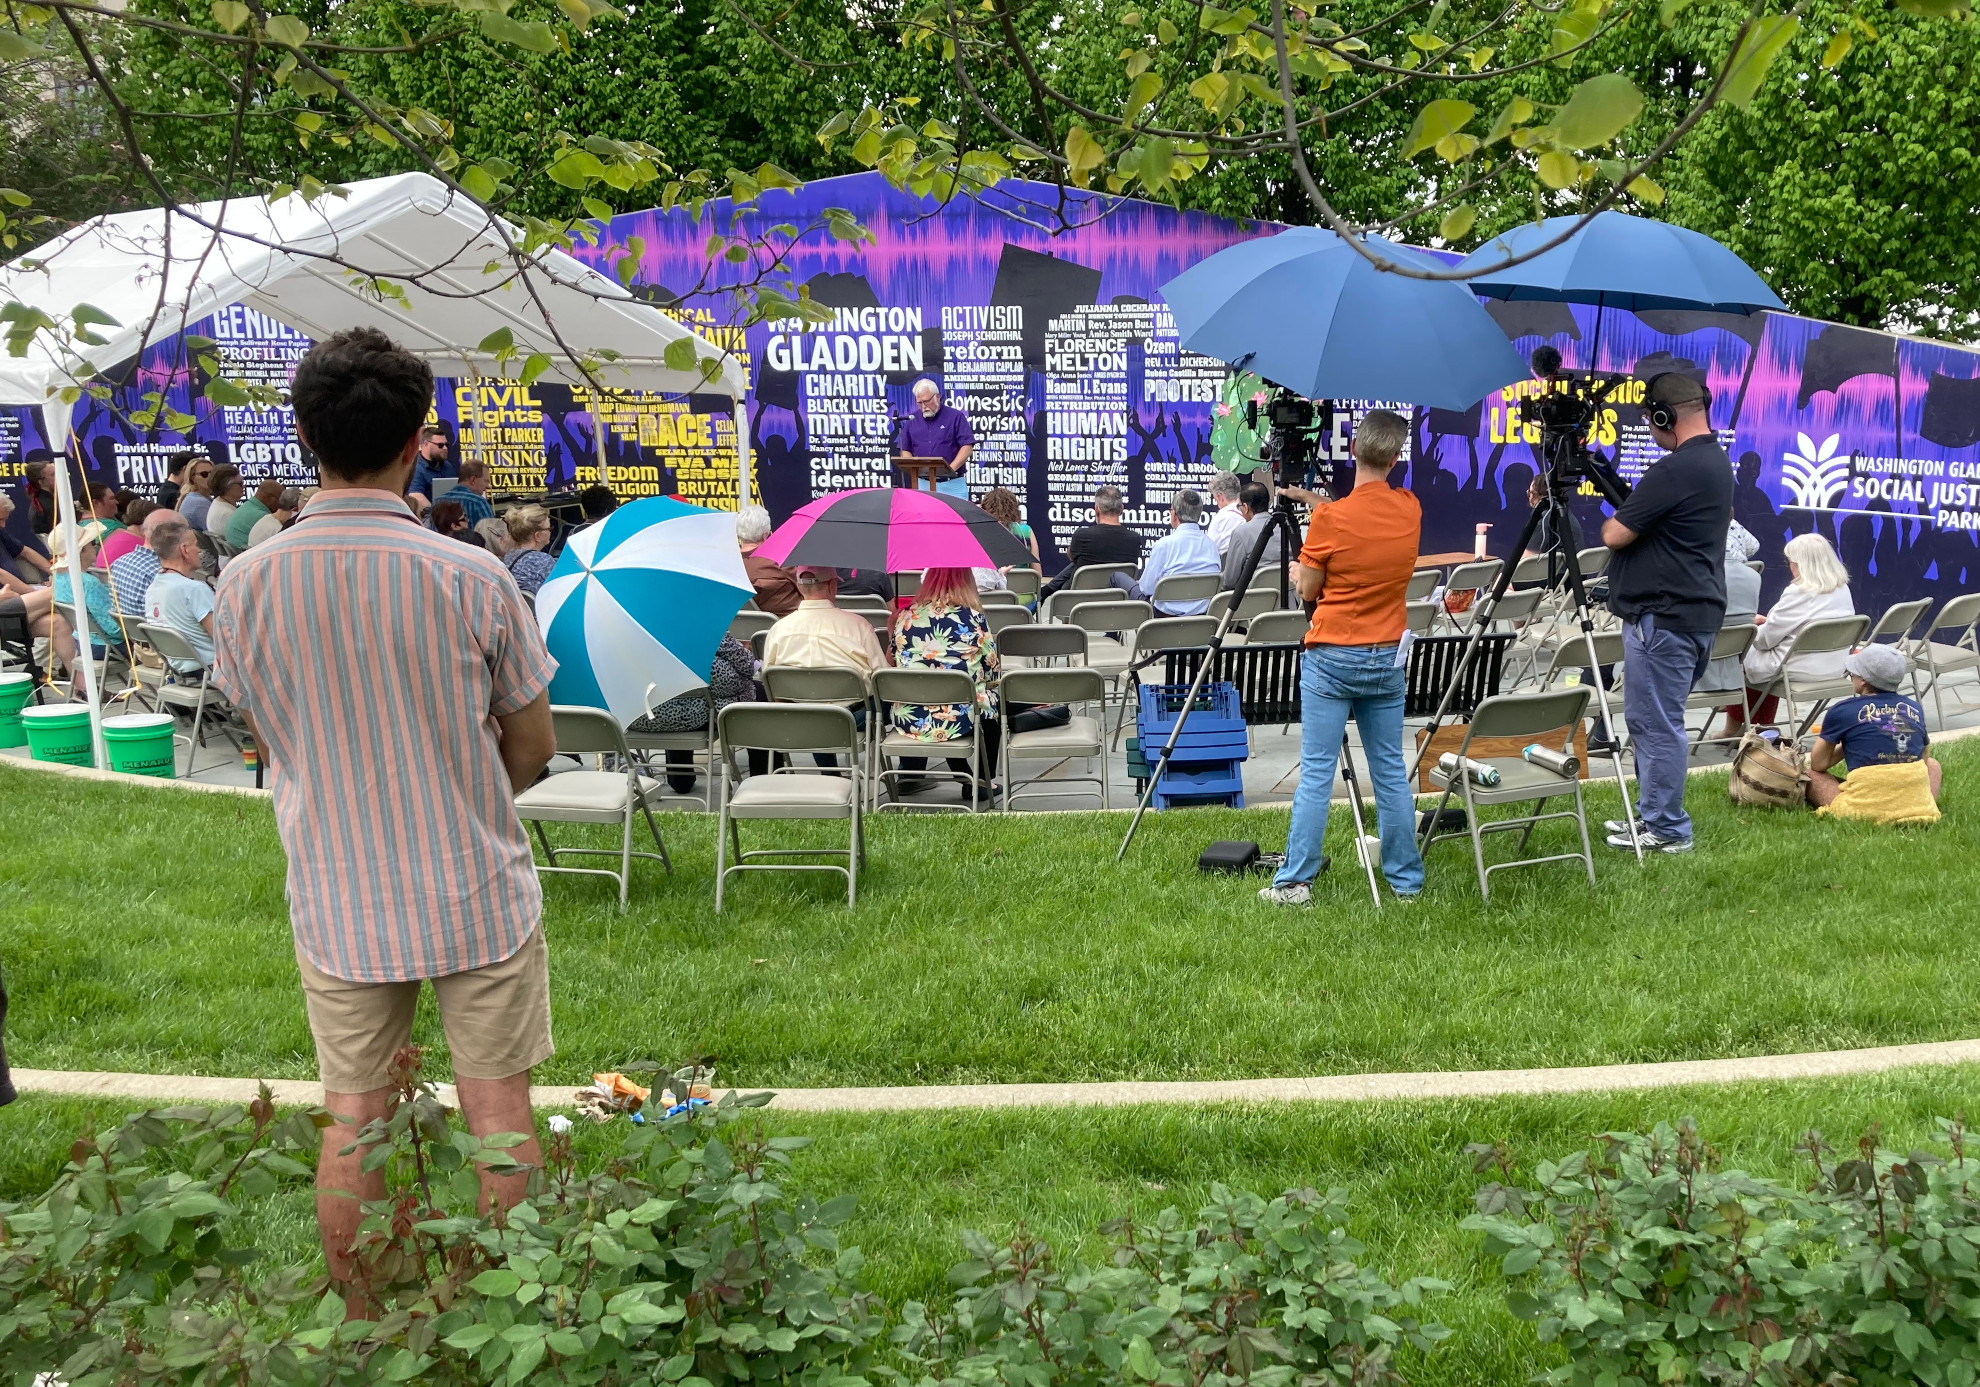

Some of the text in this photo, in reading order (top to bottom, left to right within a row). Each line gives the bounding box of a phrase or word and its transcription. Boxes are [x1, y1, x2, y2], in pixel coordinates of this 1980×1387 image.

[1074, 304, 1119, 313] JULIANNA
[1120, 304, 1160, 312] COCHRAN
[941, 306, 1023, 330] ACTIVISM
[1048, 319, 1086, 331] MARTIN
[1088, 320, 1133, 329] Rev. Jason
[942, 331, 973, 340] JOSEPH
[1088, 330, 1154, 338] Anita Smith Ward
[943, 341, 1024, 360] reform
[1044, 339, 1127, 352] FLORENCE
[1144, 338, 1176, 354] Ozem
[766, 335, 924, 372] GLADDEN
[246, 361, 284, 369] Stephens
[943, 362, 957, 372] DR.
[996, 362, 1024, 372] CAPLAN
[1045, 353, 1127, 371] MELTON
[1145, 357, 1163, 367] REV.
[1198, 369, 1226, 377] Herrera
[806, 374, 887, 396] CHARITY
[1046, 379, 1128, 394] Naomi J. Evans
[1144, 379, 1225, 403] PROTEST
[455, 386, 542, 406] CIVIL
[944, 389, 1025, 412] domestic
[807, 399, 888, 413] BLACK LIVES
[1046, 401, 1128, 410] RETRIBUTION
[224, 412, 279, 424] HEALTH
[808, 414, 890, 435] MATTER
[1047, 412, 1128, 435] HUMAN
[459, 428, 544, 443] HARIET PARKER
[637, 413, 714, 447] RACE
[987, 432, 1026, 441] Lumpkin
[808, 436, 890, 444] Dr. James E. Coulter
[114, 443, 148, 453] David
[193, 443, 209, 453] Sr.
[228, 443, 302, 465] LGBTQ
[809, 445, 833, 453] Nancy
[865, 446, 890, 454] Jeffrey
[1047, 437, 1128, 460] RIGHTS
[810, 453, 891, 470] cultural
[972, 451, 1027, 462] JENKINS DAVIS
[1048, 461, 1064, 472] Ned
[1065, 461, 1088, 472] Lance
[1144, 462, 1186, 473] CURTIS A.
[1855, 456, 1944, 476] WASHINGTON
[575, 466, 659, 481] FREDOM
[1047, 474, 1129, 482] GEORGE DENUCCI
[1168, 474, 1198, 482] JORDAN
[677, 481, 760, 495] BRUTALIY
[1852, 476, 1925, 503] SOCIAL
[1937, 510, 1980, 530] PARK
